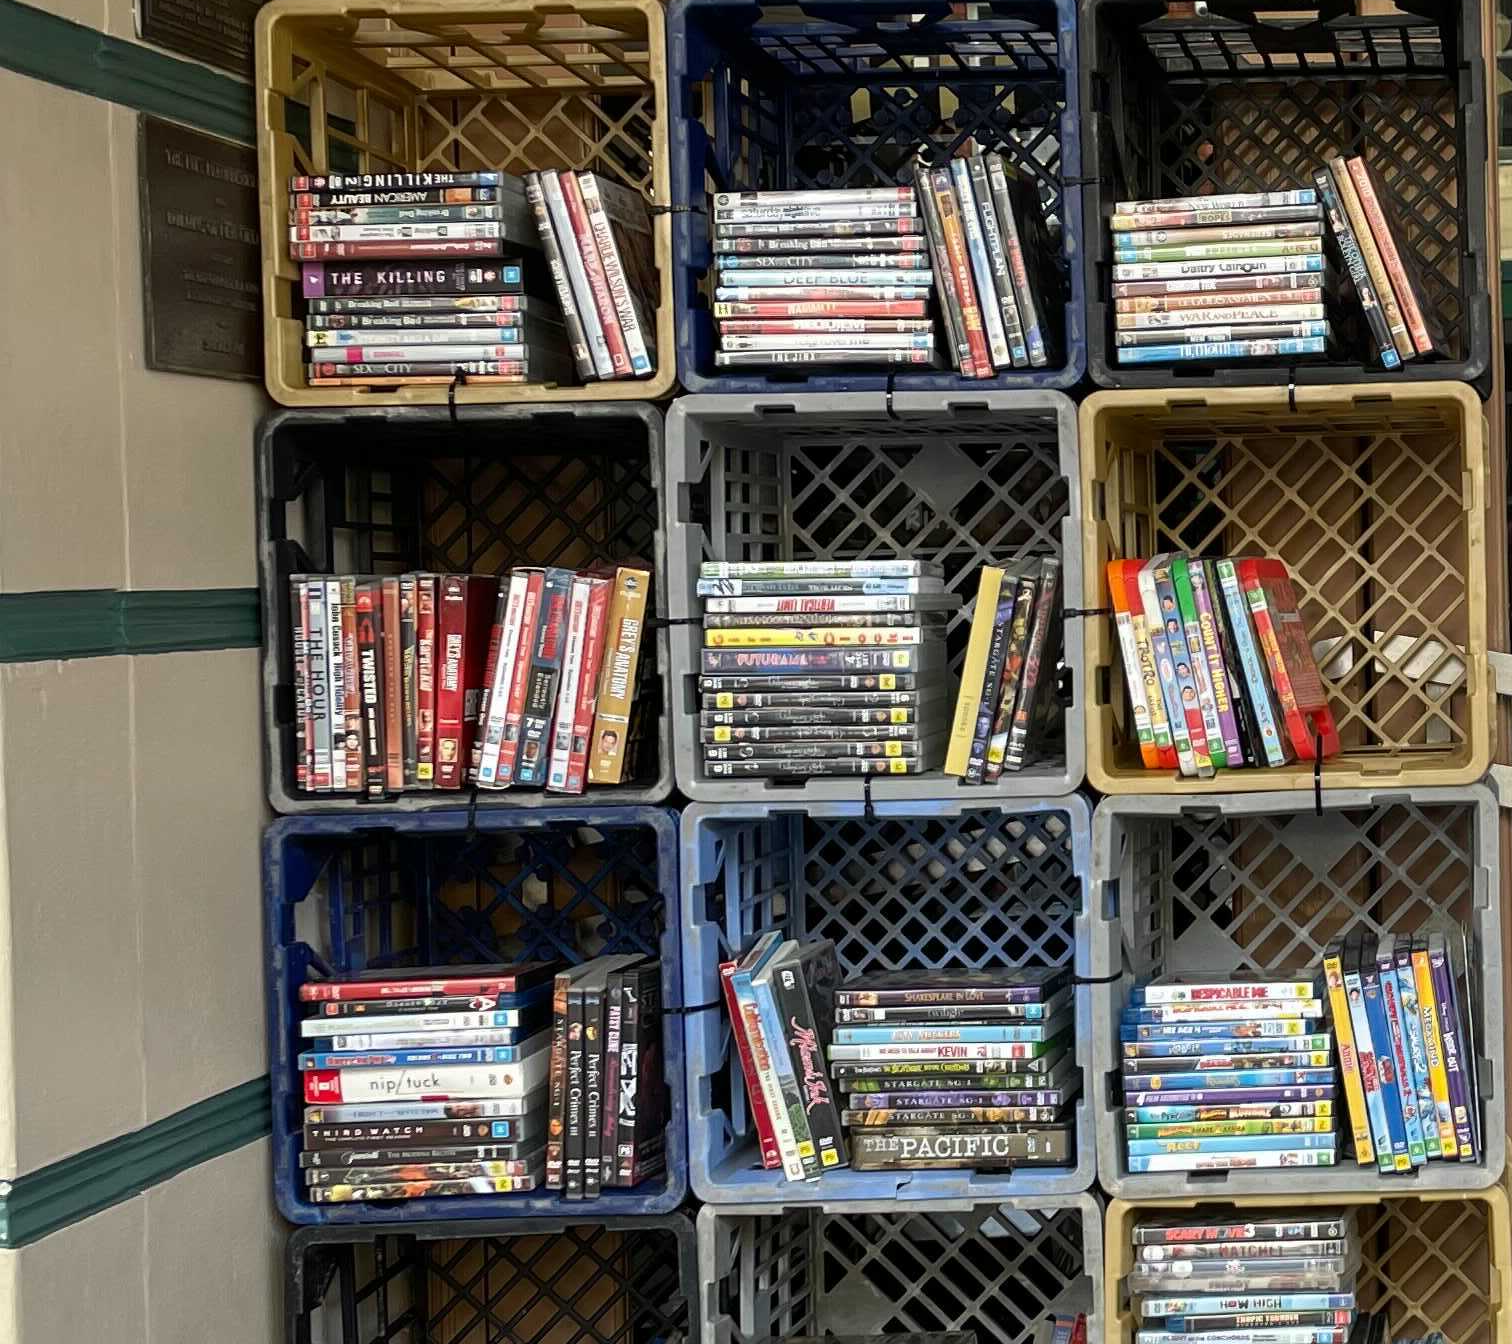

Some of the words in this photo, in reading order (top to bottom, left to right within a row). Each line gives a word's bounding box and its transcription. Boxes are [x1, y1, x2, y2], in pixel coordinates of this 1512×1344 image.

[364, 173, 436, 188] KILLING
[329, 193, 377, 206] BEAUTY
[378, 191, 428, 203] AMERICAN
[330, 272, 363, 285] THE
[377, 270, 446, 285] KILLING
[309, 628, 324, 658] THE
[624, 617, 642, 655] GREY'S
[1196, 610, 1220, 653] COUNT
[1206, 652, 1222, 667] IT
[361, 649, 377, 705] TWISTED
[609, 649, 635, 701] ANATOMY
[312, 670, 326, 722] HOUR
[1209, 667, 1234, 714] HIGHER
[1190, 985, 1252, 1001] DESPICABLE
[609, 1005, 621, 1030] PATSY
[937, 1046, 969, 1058] KEVIN
[369, 1069, 441, 1095] nip/tuck
[568, 1049, 582, 1087] Perfect
[586, 1053, 600, 1088] Perfect
[569, 1088, 583, 1125] Crimes
[587, 1091, 601, 1129] Crimes
[311, 1129, 362, 1138] THIRD
[369, 1126, 425, 1136] WATCH
[863, 1138, 900, 1152] THE
[899, 1135, 1010, 1157] PACIFIC
